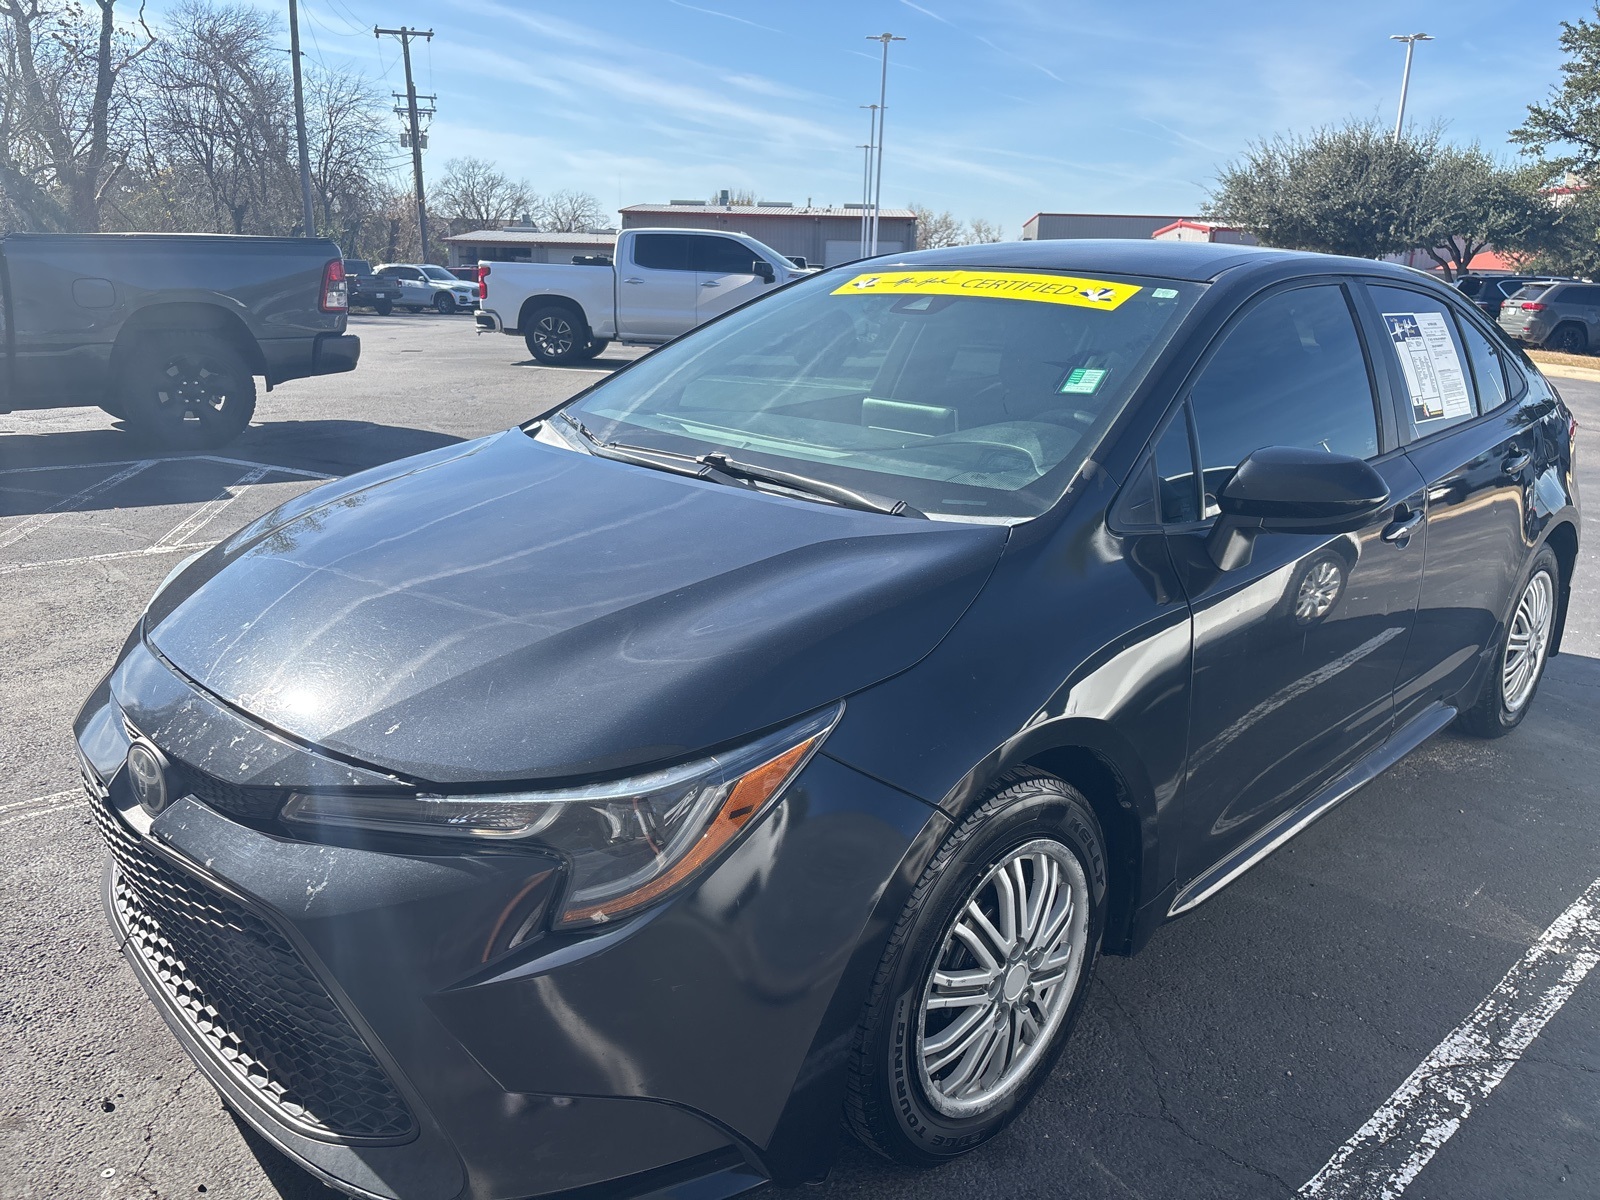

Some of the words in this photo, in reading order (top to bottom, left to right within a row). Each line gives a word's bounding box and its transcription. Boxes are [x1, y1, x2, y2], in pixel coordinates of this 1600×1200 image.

[961, 278, 1078, 295] CERTIFIED
[1068, 818, 1105, 886] KELLY
[894, 1022, 928, 1138] TOURING
